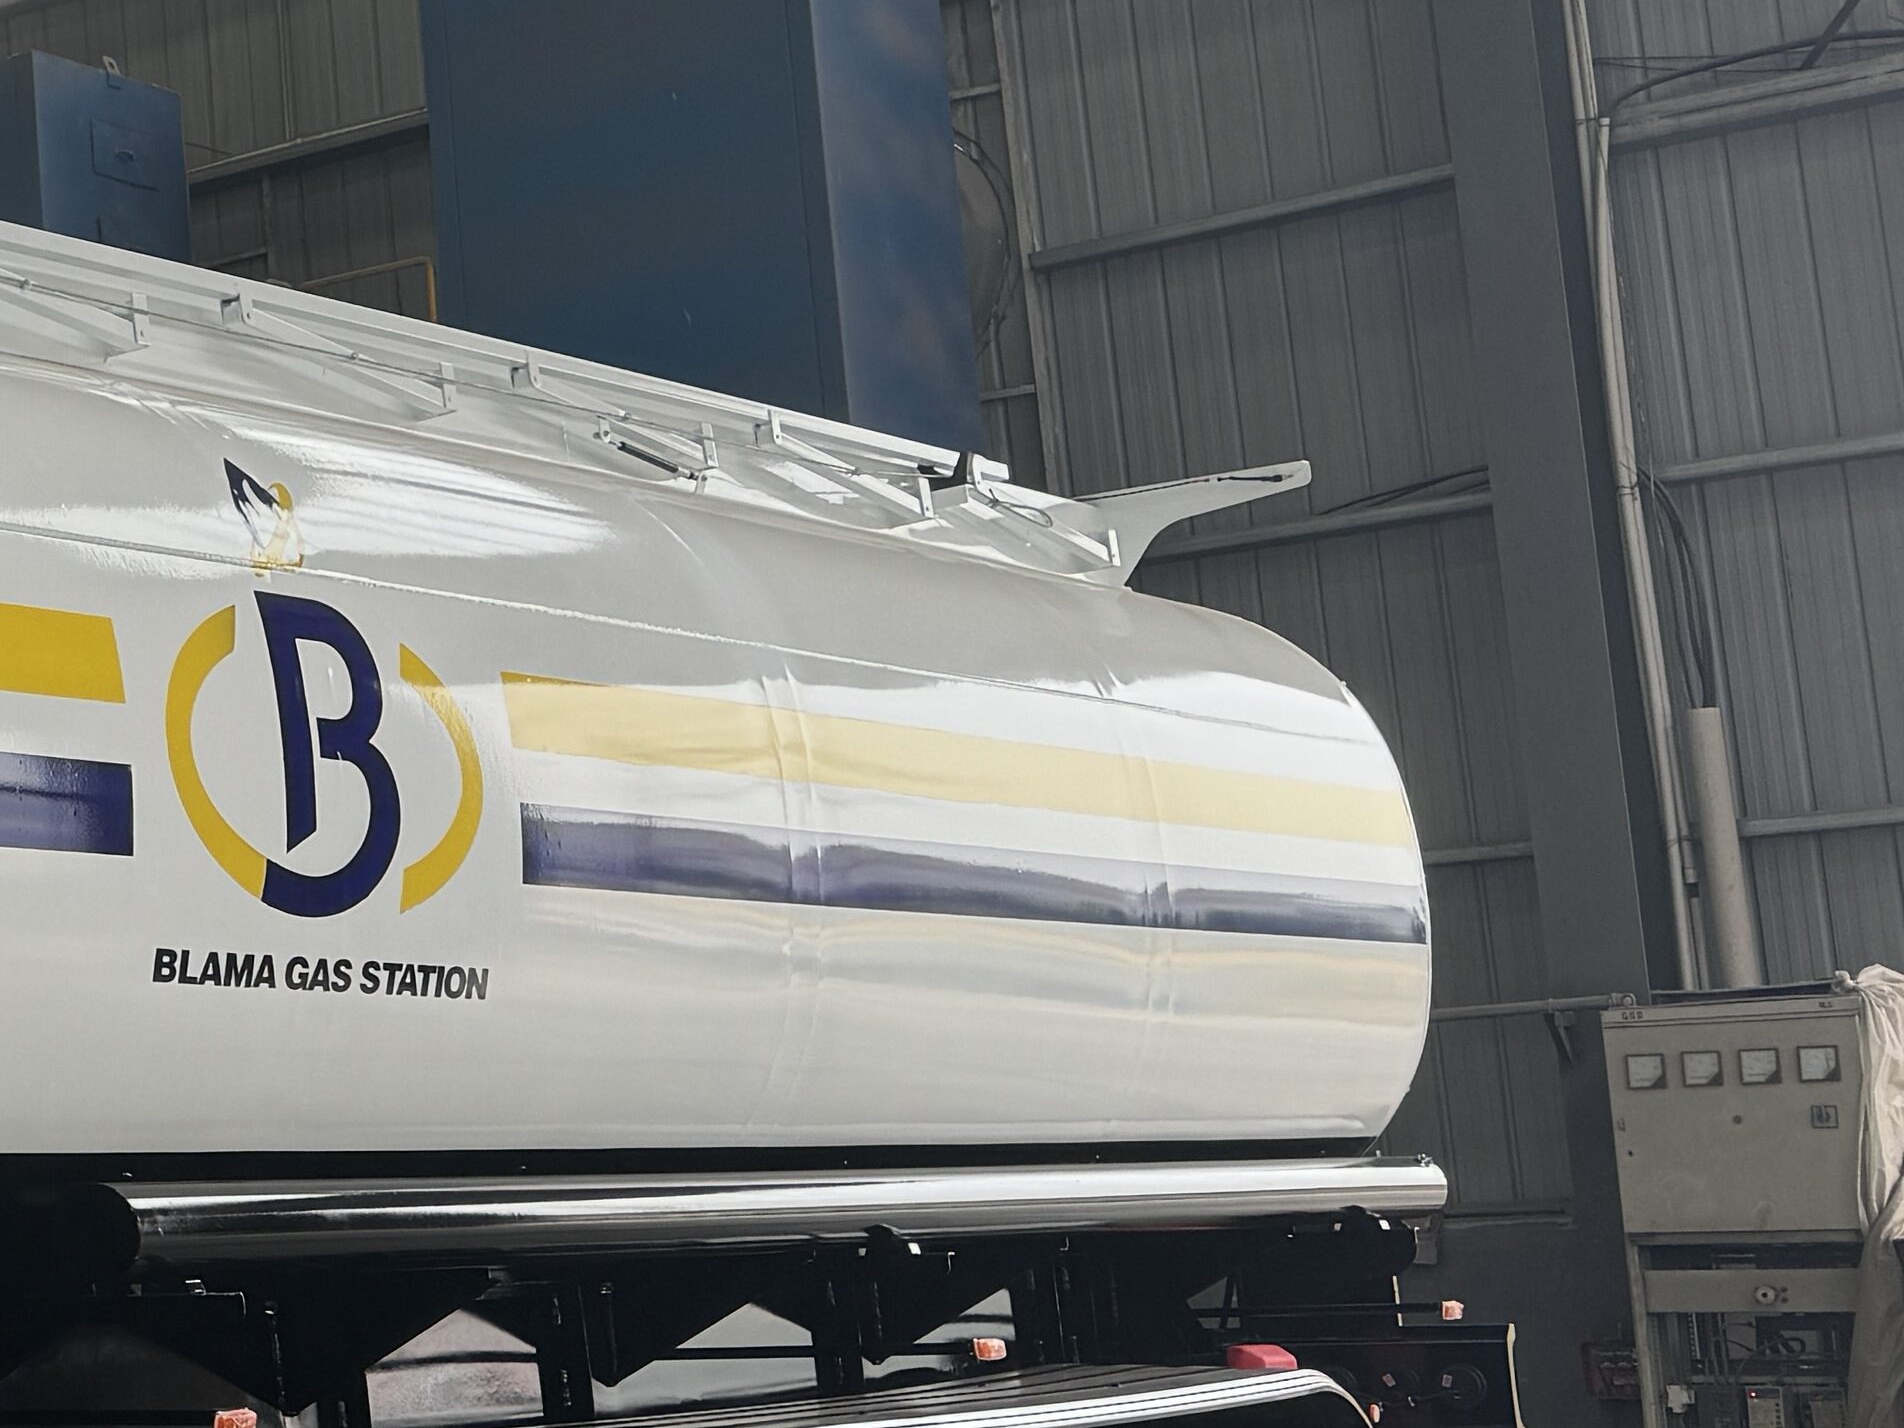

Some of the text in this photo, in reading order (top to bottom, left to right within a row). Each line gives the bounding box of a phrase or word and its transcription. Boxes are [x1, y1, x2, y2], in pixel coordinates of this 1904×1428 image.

[152, 948, 489, 1000] BLAMA GAS STATION
